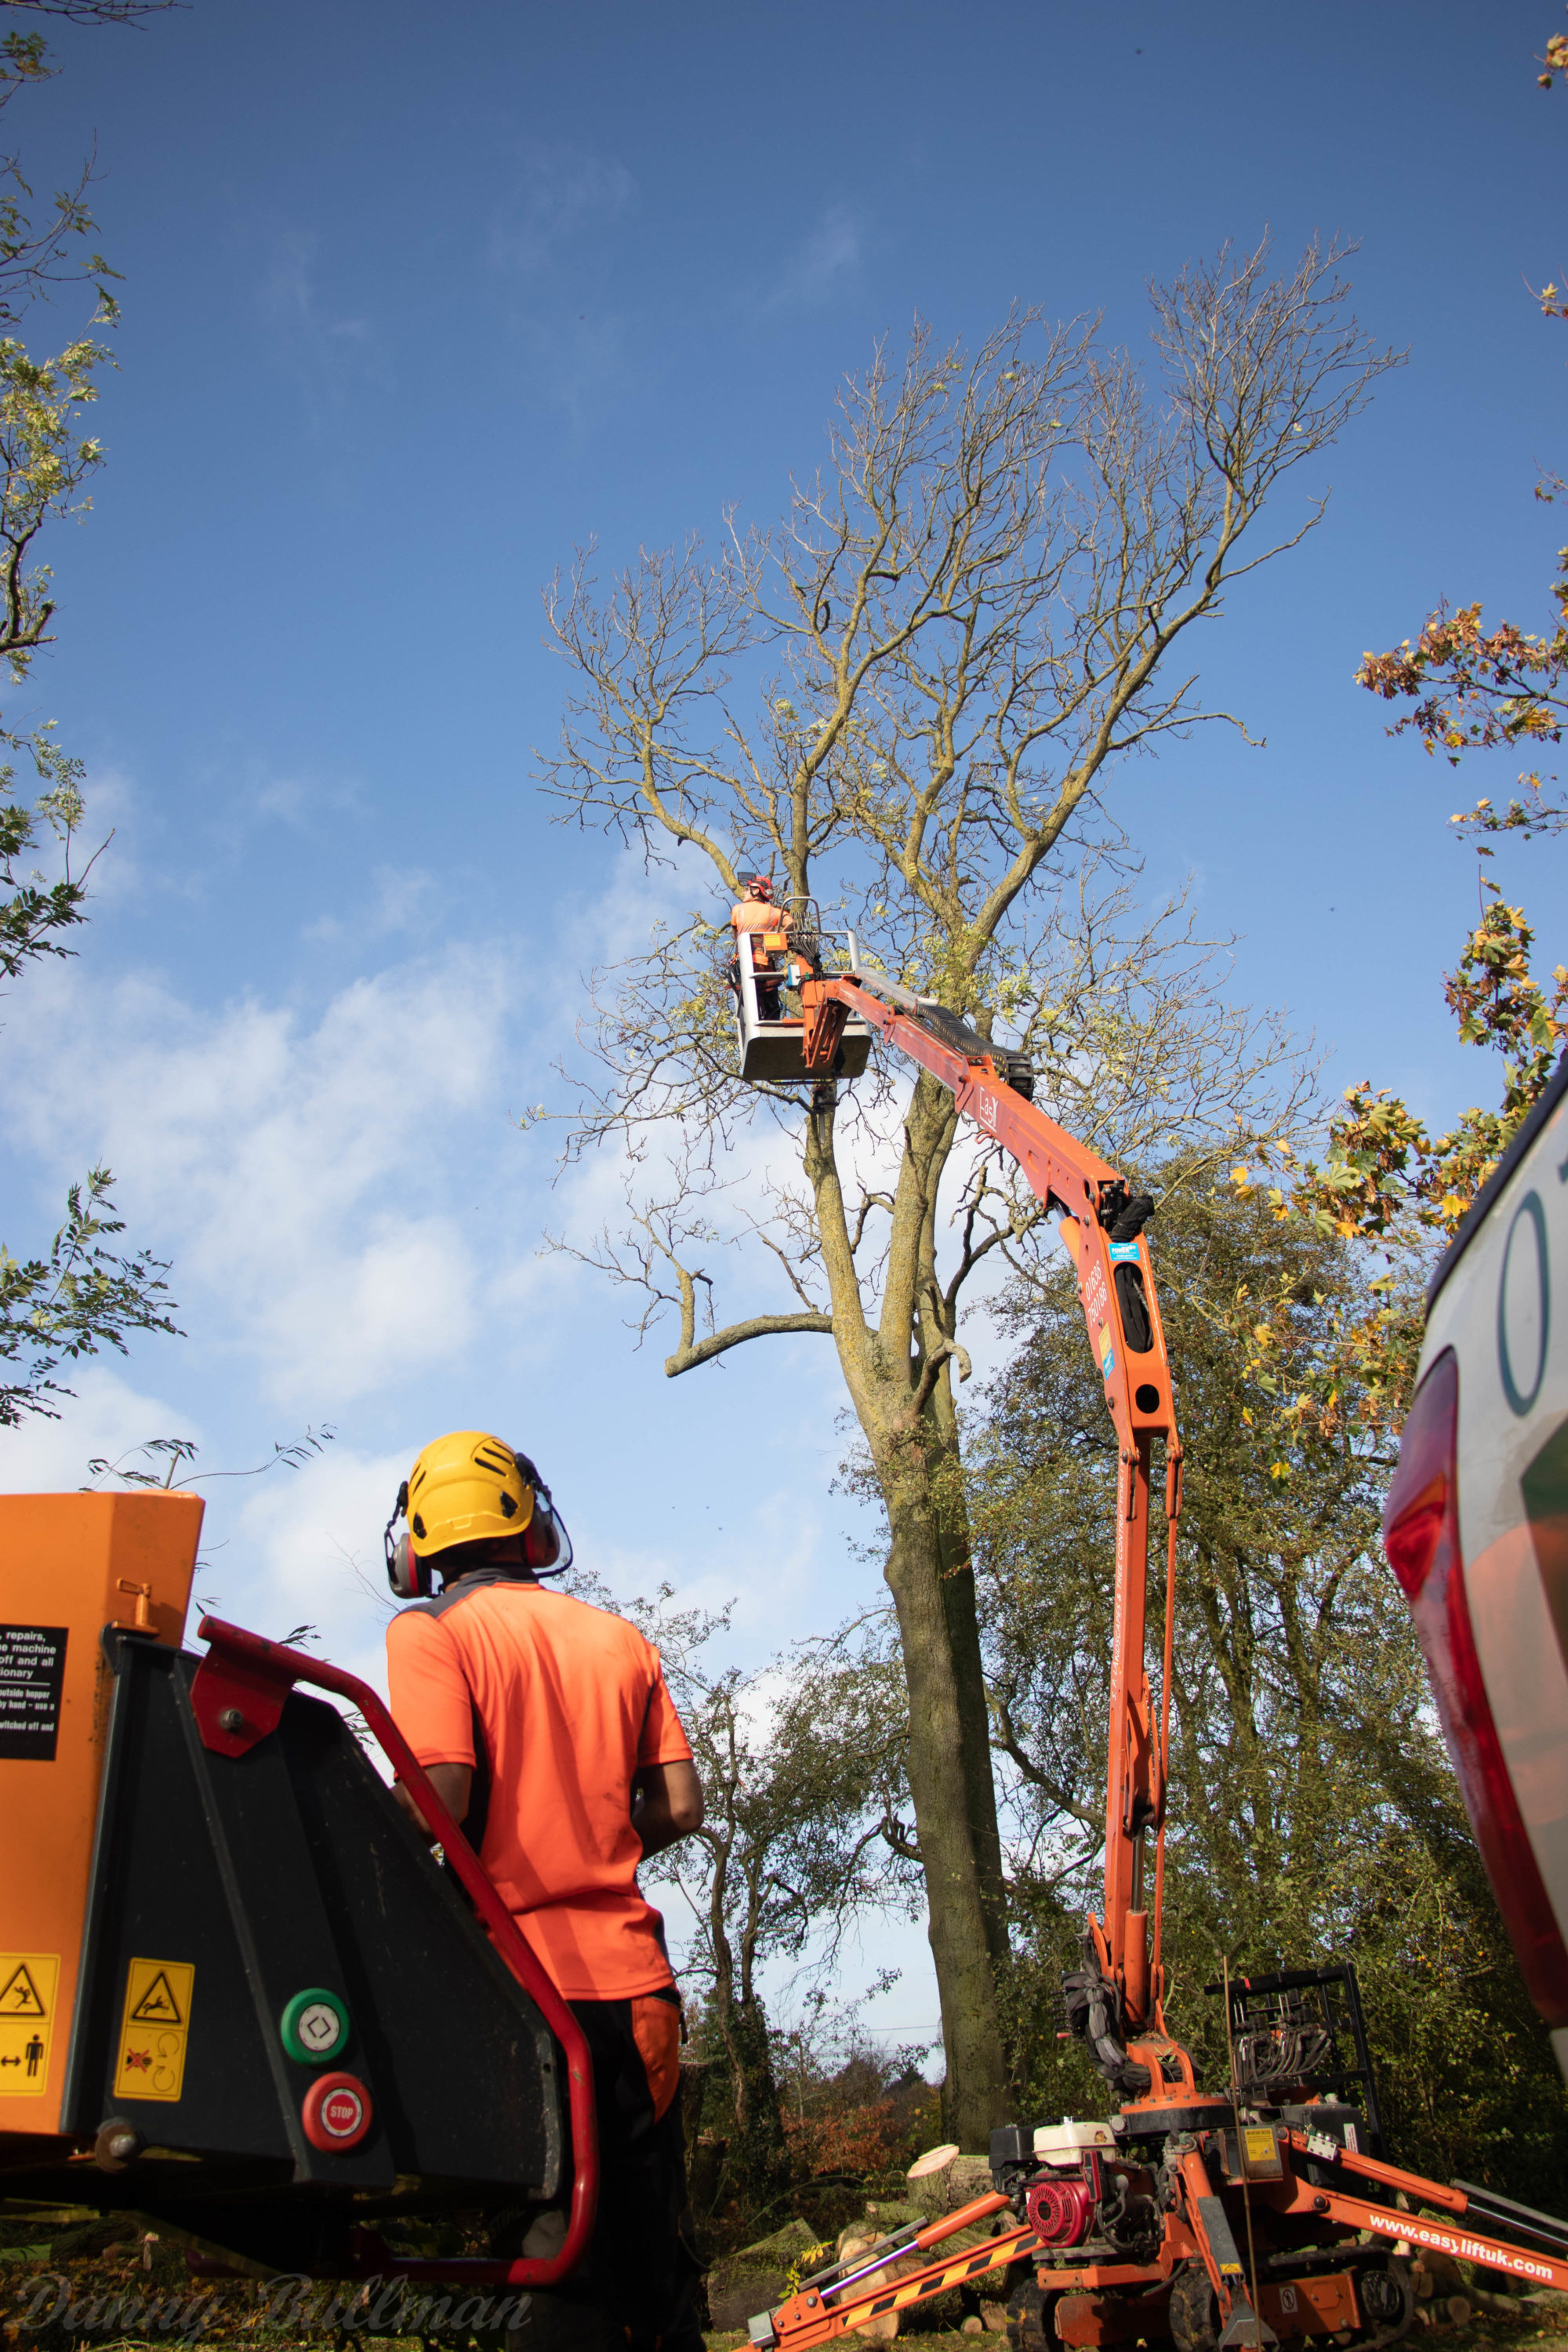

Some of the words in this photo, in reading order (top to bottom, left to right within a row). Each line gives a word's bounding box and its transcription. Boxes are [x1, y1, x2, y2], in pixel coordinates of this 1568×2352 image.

[1497, 1152, 1568, 1416] 0
[1116, 1593, 1122, 1602] &
[6, 1632, 45, 1642] repairs,
[1112, 1602, 1122, 1675] LANDSCAPES
[13, 1644, 56, 1654] machine
[17, 1657, 38, 1666] and
[42, 1657, 54, 1667] all
[0, 1667, 34, 1679] ionary
[26, 1689, 50, 1700] hopper
[9, 1700, 27, 1709] hand
[28, 1722, 39, 1730] off
[42, 1722, 54, 1731] and
[330, 2105, 354, 2119] STOP
[1370, 2214, 1553, 2280] www.easyliftuk.com
